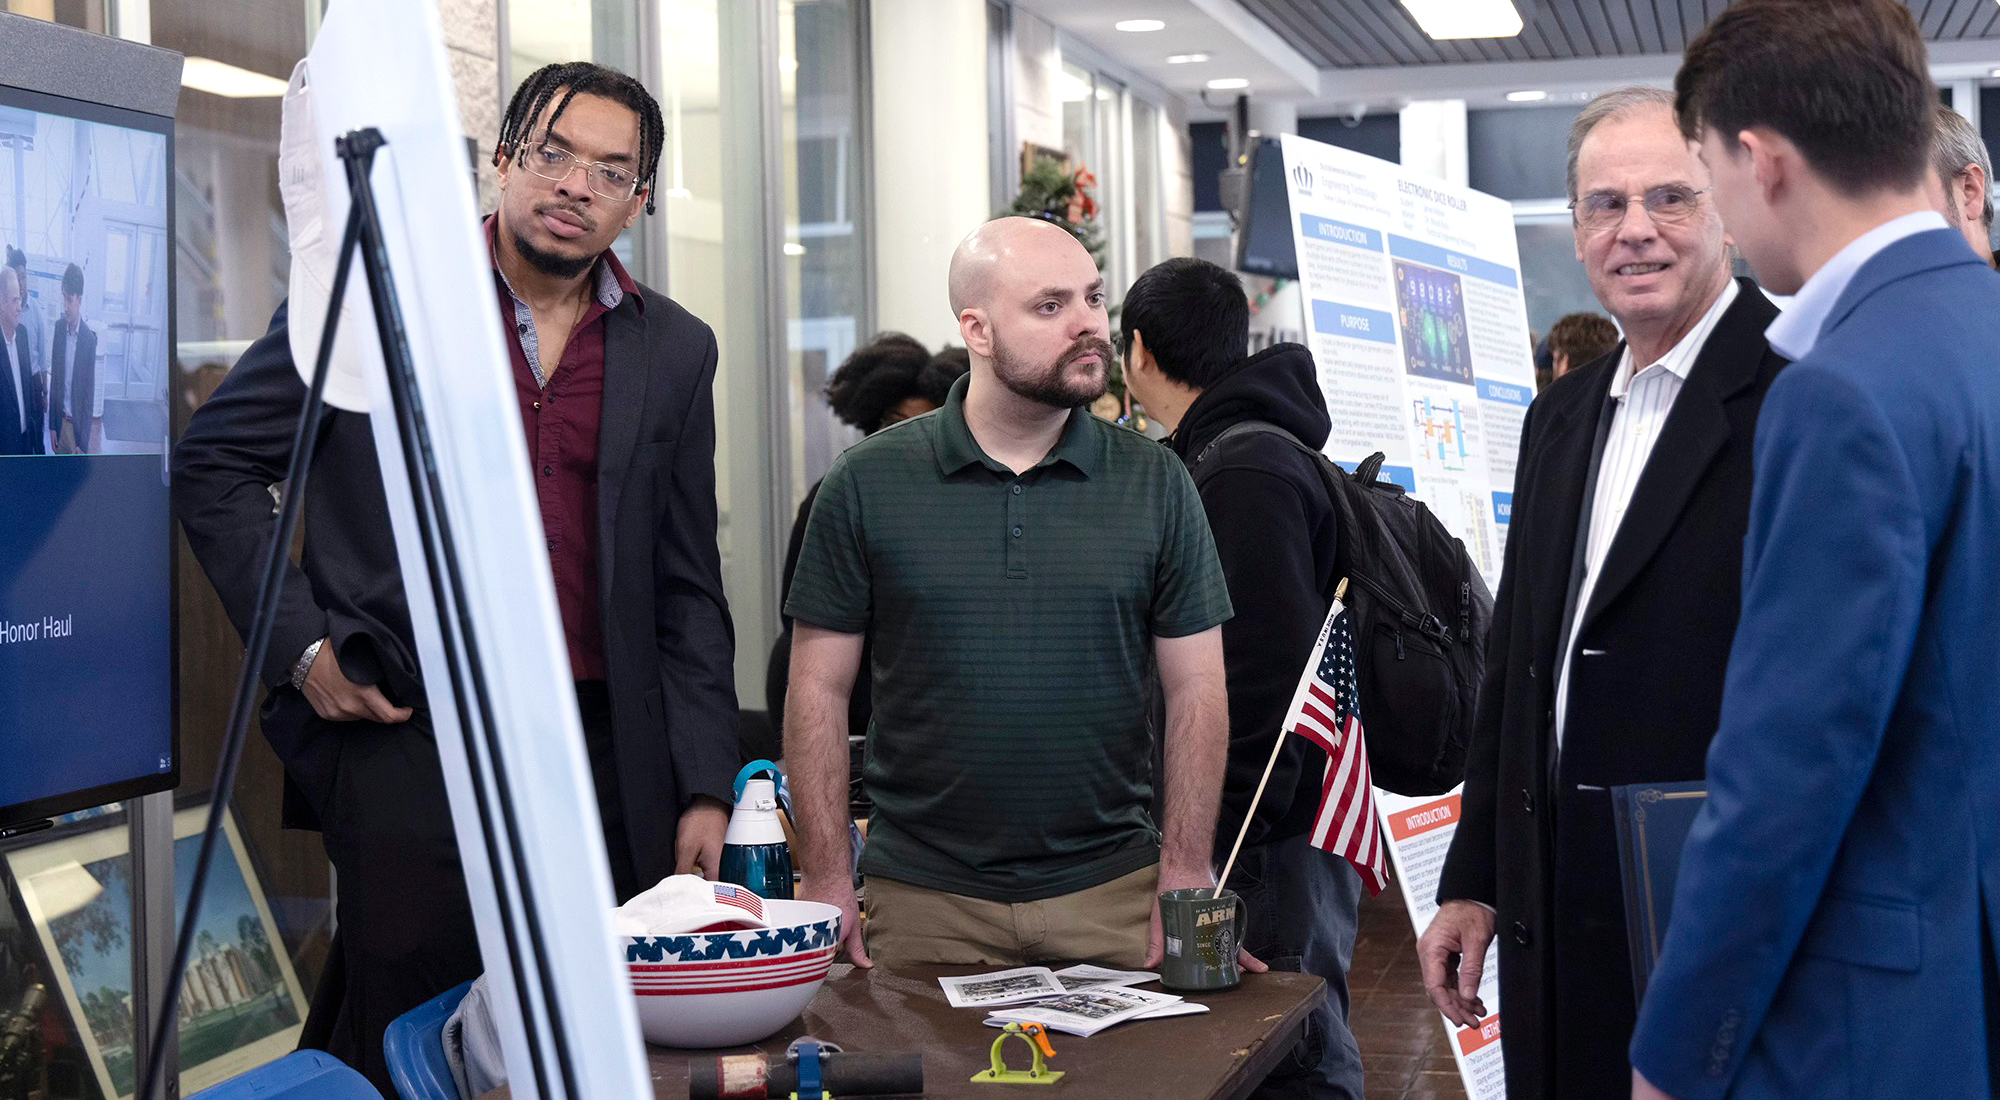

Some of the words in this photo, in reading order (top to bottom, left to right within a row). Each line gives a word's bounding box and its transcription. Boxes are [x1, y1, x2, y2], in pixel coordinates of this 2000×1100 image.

[1397, 179, 1433, 202] ELECTRONIC
[1433, 190, 1446, 206] DICE
[1446, 194, 1468, 212] ROLLER
[1318, 222, 1368, 245] INTRODUCTION
[1446, 254, 1468, 270] RESULTS
[1340, 314, 1370, 331] PURPOSE
[1488, 384, 1522, 402] CONCLUSIONS
[0, 620, 40, 644] Honor
[43, 613, 72, 639] Haul
[1405, 805, 1452, 830] INTRODUCTION
